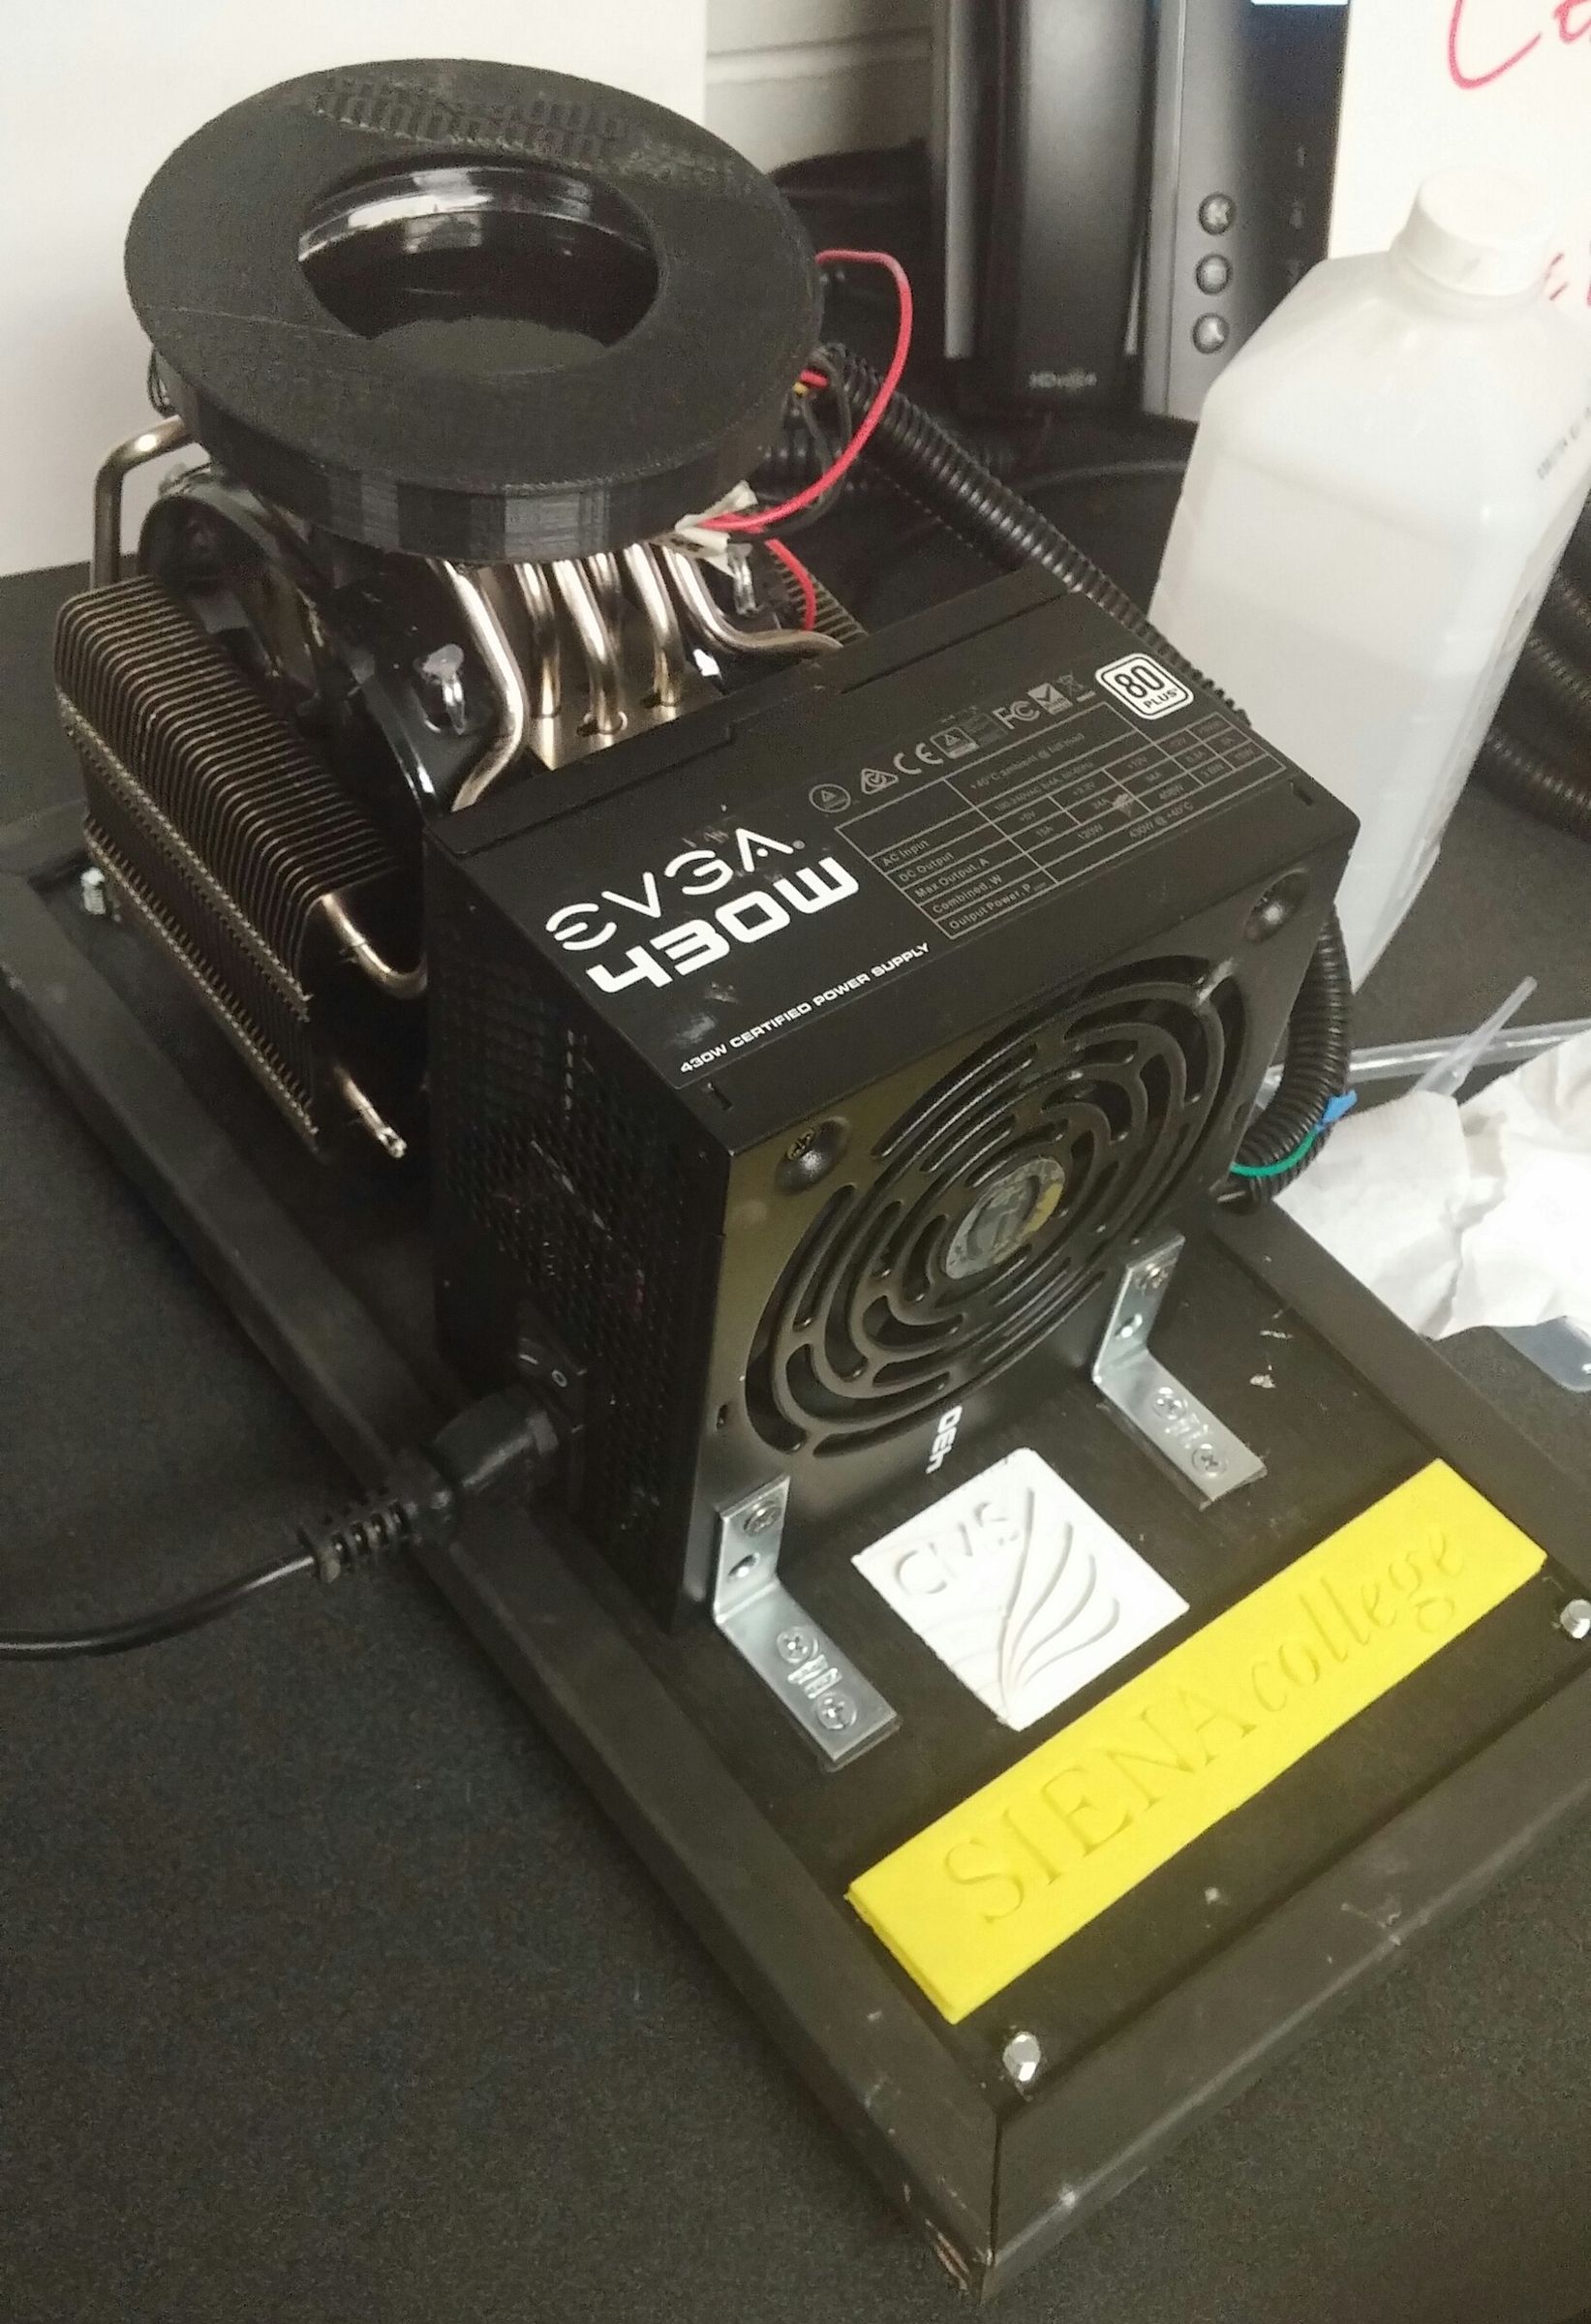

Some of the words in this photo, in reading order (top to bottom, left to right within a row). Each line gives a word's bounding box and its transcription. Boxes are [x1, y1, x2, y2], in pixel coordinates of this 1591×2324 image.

[1114, 665, 1165, 698] 80
[1143, 688, 1178, 708] PLUS
[881, 851, 900, 868] AC
[901, 839, 930, 859] Input
[899, 869, 917, 883] DC
[916, 851, 955, 874] Output
[545, 827, 795, 952] EVGA
[914, 883, 938, 899] Max
[979, 856, 991, 868] A
[989, 873, 1003, 886] W
[586, 856, 859, 994] 430W
[948, 903, 989, 931] Output
[680, 1043, 728, 1073] 430W
[728, 1001, 812, 1049] CERTIFIED
[811, 972, 872, 1007] POWER
[871, 941, 931, 978] SUPPLY
[926, 1405, 963, 1474] 430
